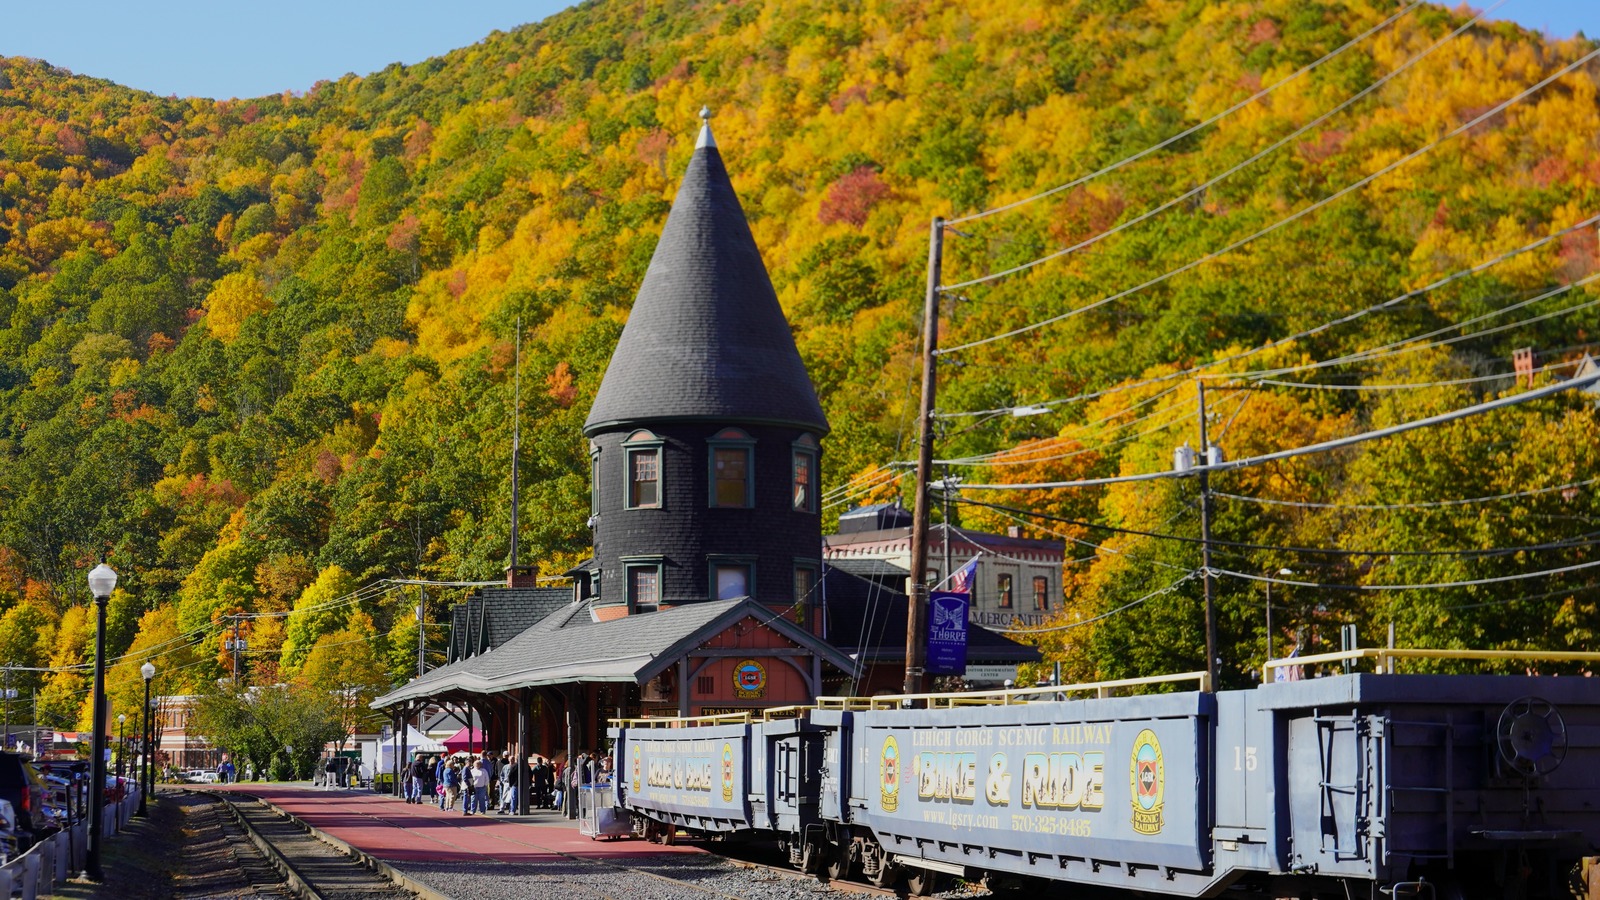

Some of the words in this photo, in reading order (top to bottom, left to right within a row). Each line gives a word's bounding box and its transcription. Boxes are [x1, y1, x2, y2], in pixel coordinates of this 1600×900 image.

[932, 627, 966, 641] THORPE
[758, 708, 796, 716] TKETS
[912, 730, 952, 747] LEHIGH
[955, 729, 993, 746] GORGE
[998, 728, 1047, 746] SCENIC
[1052, 725, 1113, 745] RAILWAY
[1233, 746, 1258, 771] 15
[918, 752, 976, 803] BIKE
[985, 752, 1012, 804] &
[1022, 751, 1105, 809] RIDE
[924, 808, 998, 831] www.lgsry.com
[1012, 814, 1092, 837] 570-325-8485
[1134, 811, 1159, 823] SCENIC
[1134, 821, 1159, 832] RAILWAY
